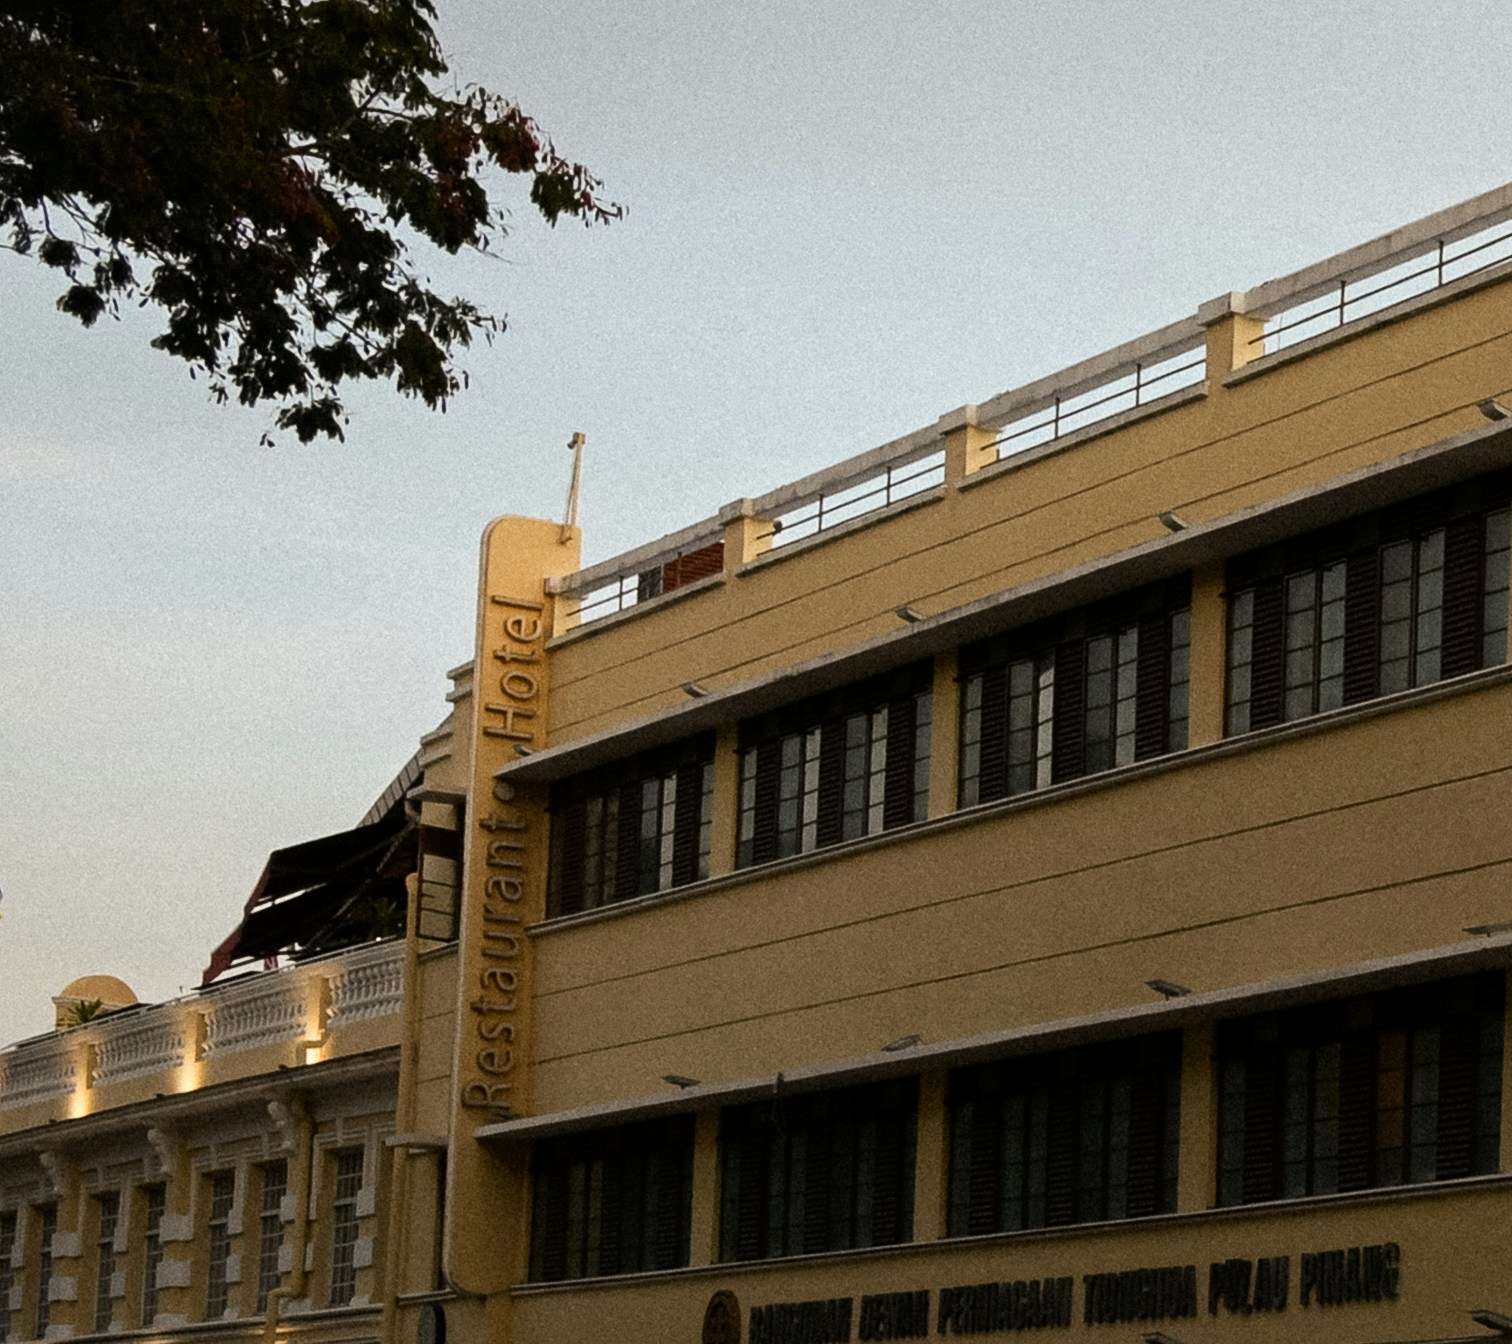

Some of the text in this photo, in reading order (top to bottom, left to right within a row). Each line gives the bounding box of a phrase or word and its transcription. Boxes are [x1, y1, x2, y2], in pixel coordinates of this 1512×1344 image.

[461, 594, 546, 1113] Restaurant Hotel
[1210, 1255, 1289, 1315] PULAU
[1302, 1242, 1402, 1308] PINANG
